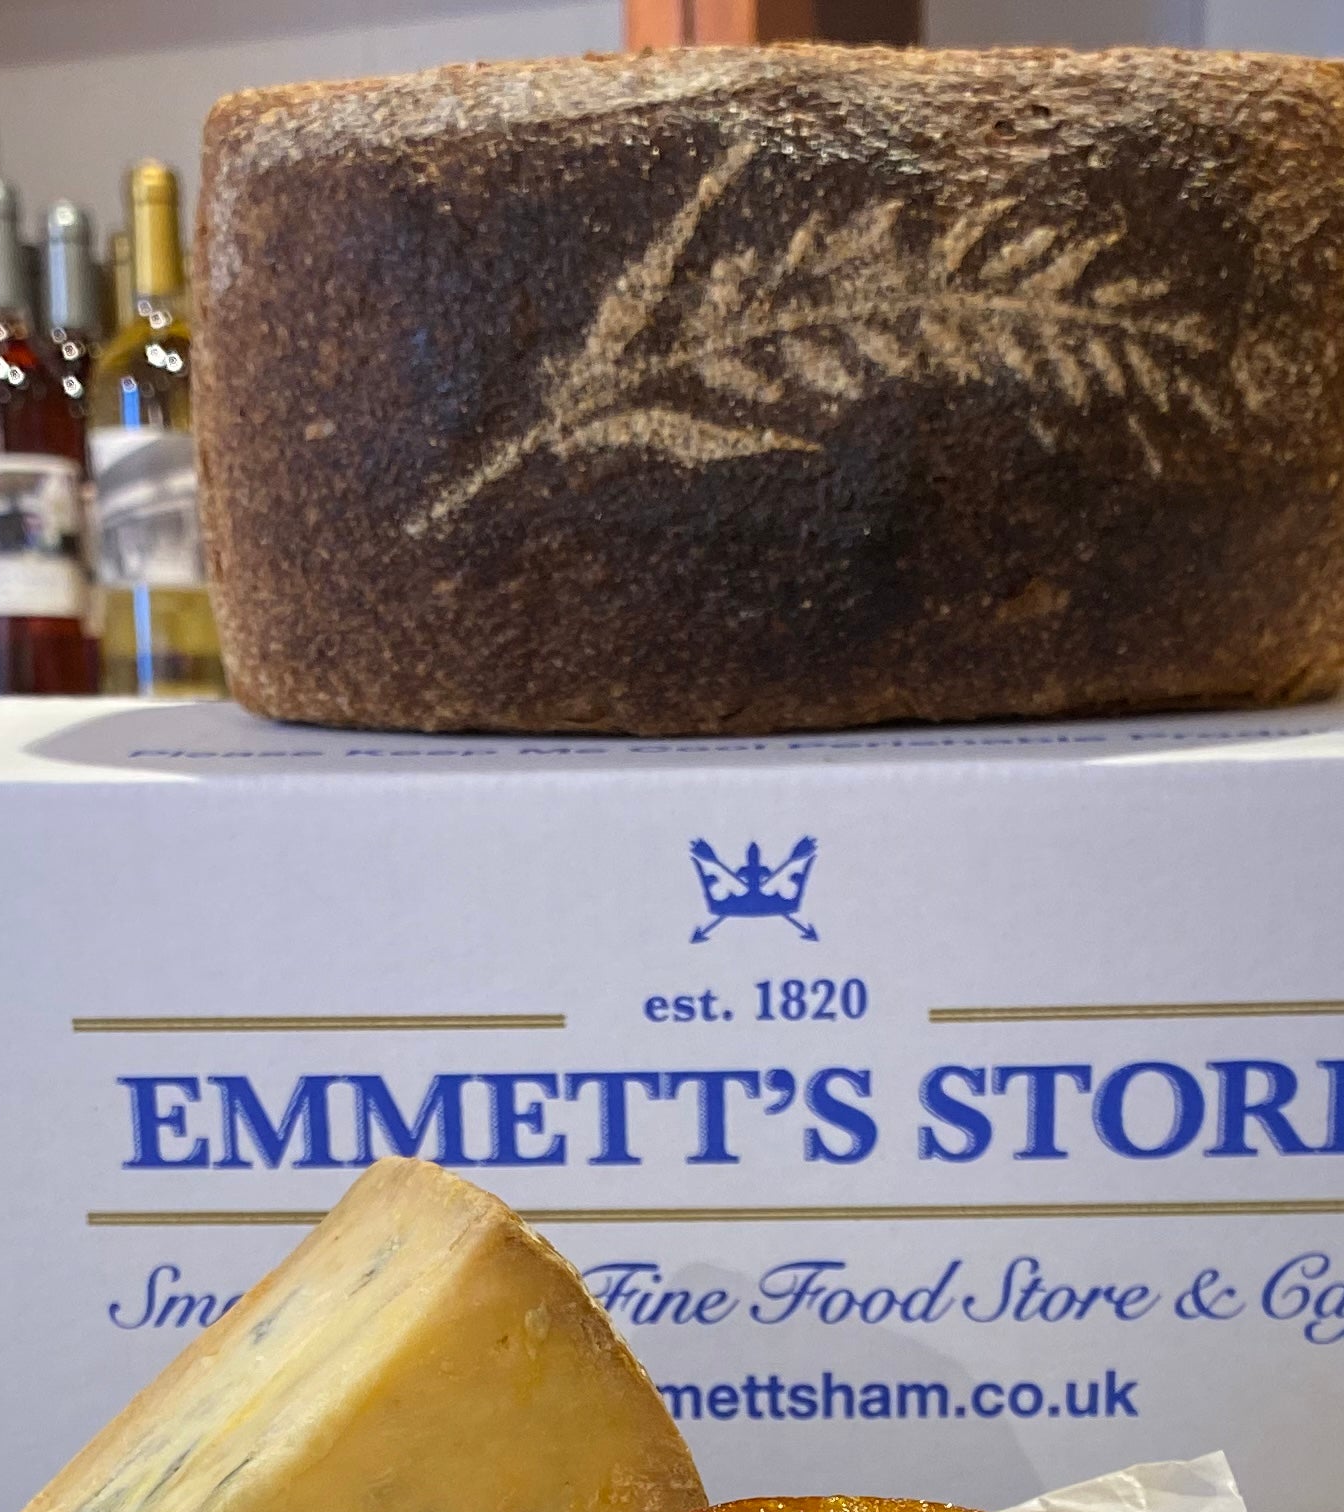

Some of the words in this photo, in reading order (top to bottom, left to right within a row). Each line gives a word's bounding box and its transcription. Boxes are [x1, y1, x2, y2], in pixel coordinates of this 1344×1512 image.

[642, 988, 735, 1023] est.
[755, 977, 869, 1021] 1820
[116, 1065, 879, 1170] EMMETT'S
[582, 1261, 740, 1326] Fine
[750, 1258, 963, 1325] Food
[962, 1255, 1162, 1323] Store
[1173, 1267, 1246, 1322] &
